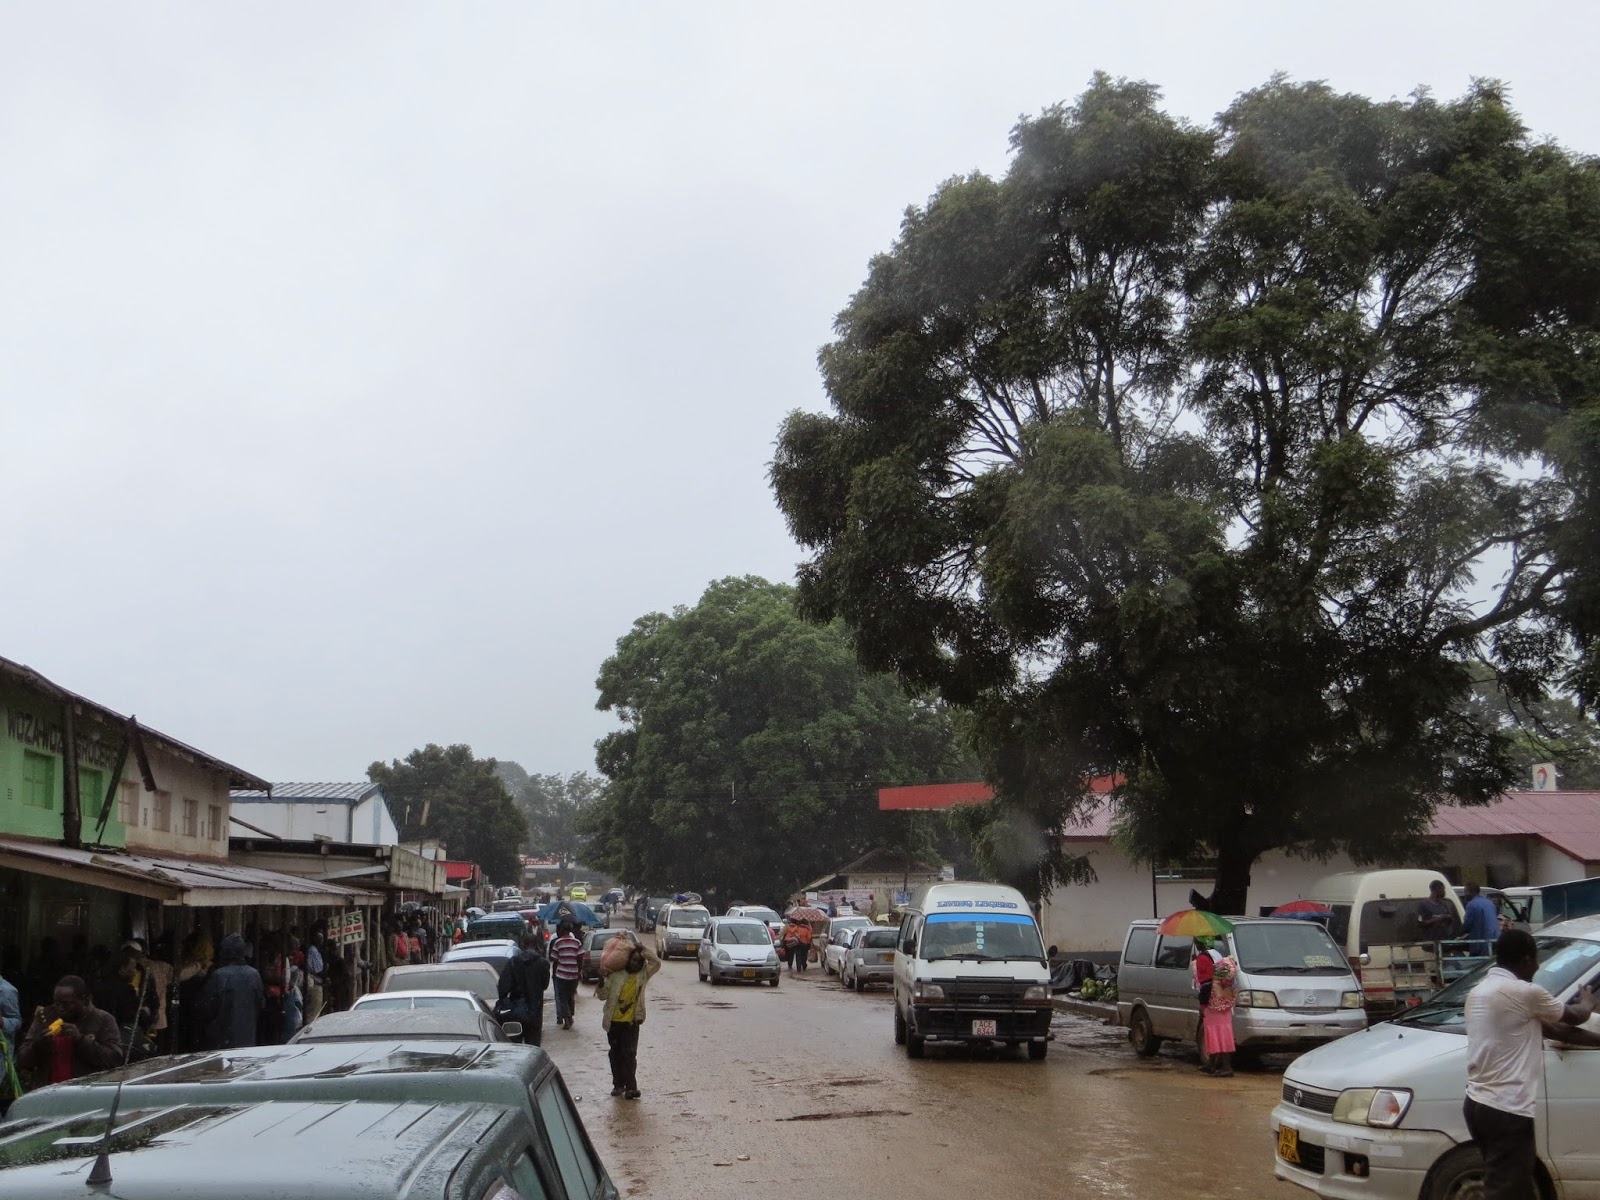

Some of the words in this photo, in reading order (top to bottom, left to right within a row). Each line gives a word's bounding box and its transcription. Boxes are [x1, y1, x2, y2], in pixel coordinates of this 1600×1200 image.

[937, 900, 973, 908] LIVING
[974, 900, 1019, 909] LEGEND
[979, 1020, 994, 1028] ACE
